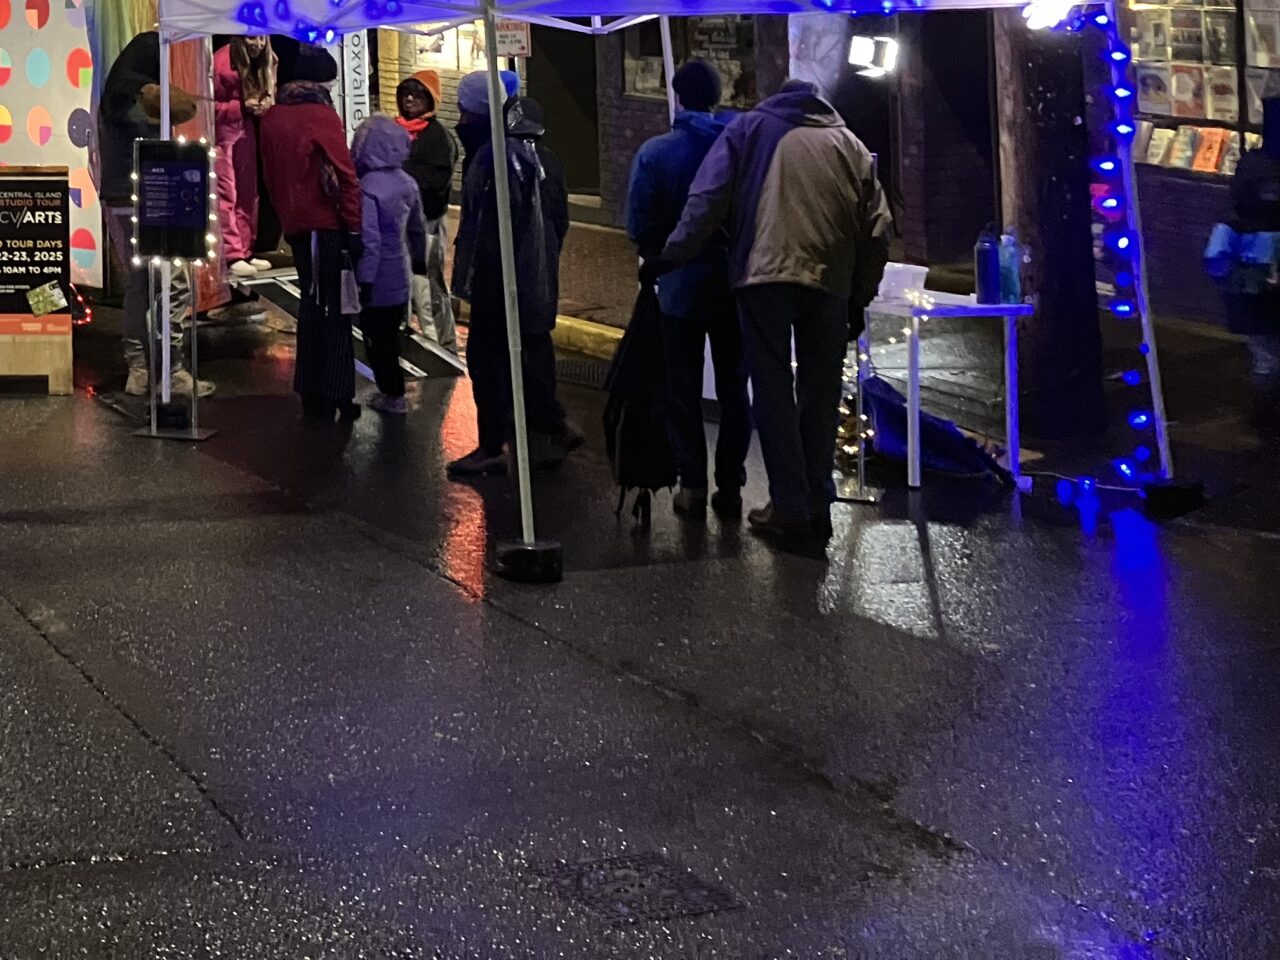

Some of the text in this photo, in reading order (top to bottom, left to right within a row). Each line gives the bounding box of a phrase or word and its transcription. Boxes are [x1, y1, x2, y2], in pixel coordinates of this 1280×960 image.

[494, 22, 528, 32] ARKING
[351, 34, 367, 132] oxvalle
[34, 191, 63, 199] ISLAND
[0, 199, 61, 207] STUDIO TOUR
[5, 239, 34, 249] TOUR
[36, 239, 63, 249] DAYS
[34, 251, 64, 261] 2025
[2, 266, 27, 275] 10AM
[28, 266, 41, 275] TO
[42, 266, 63, 275] 4PM
